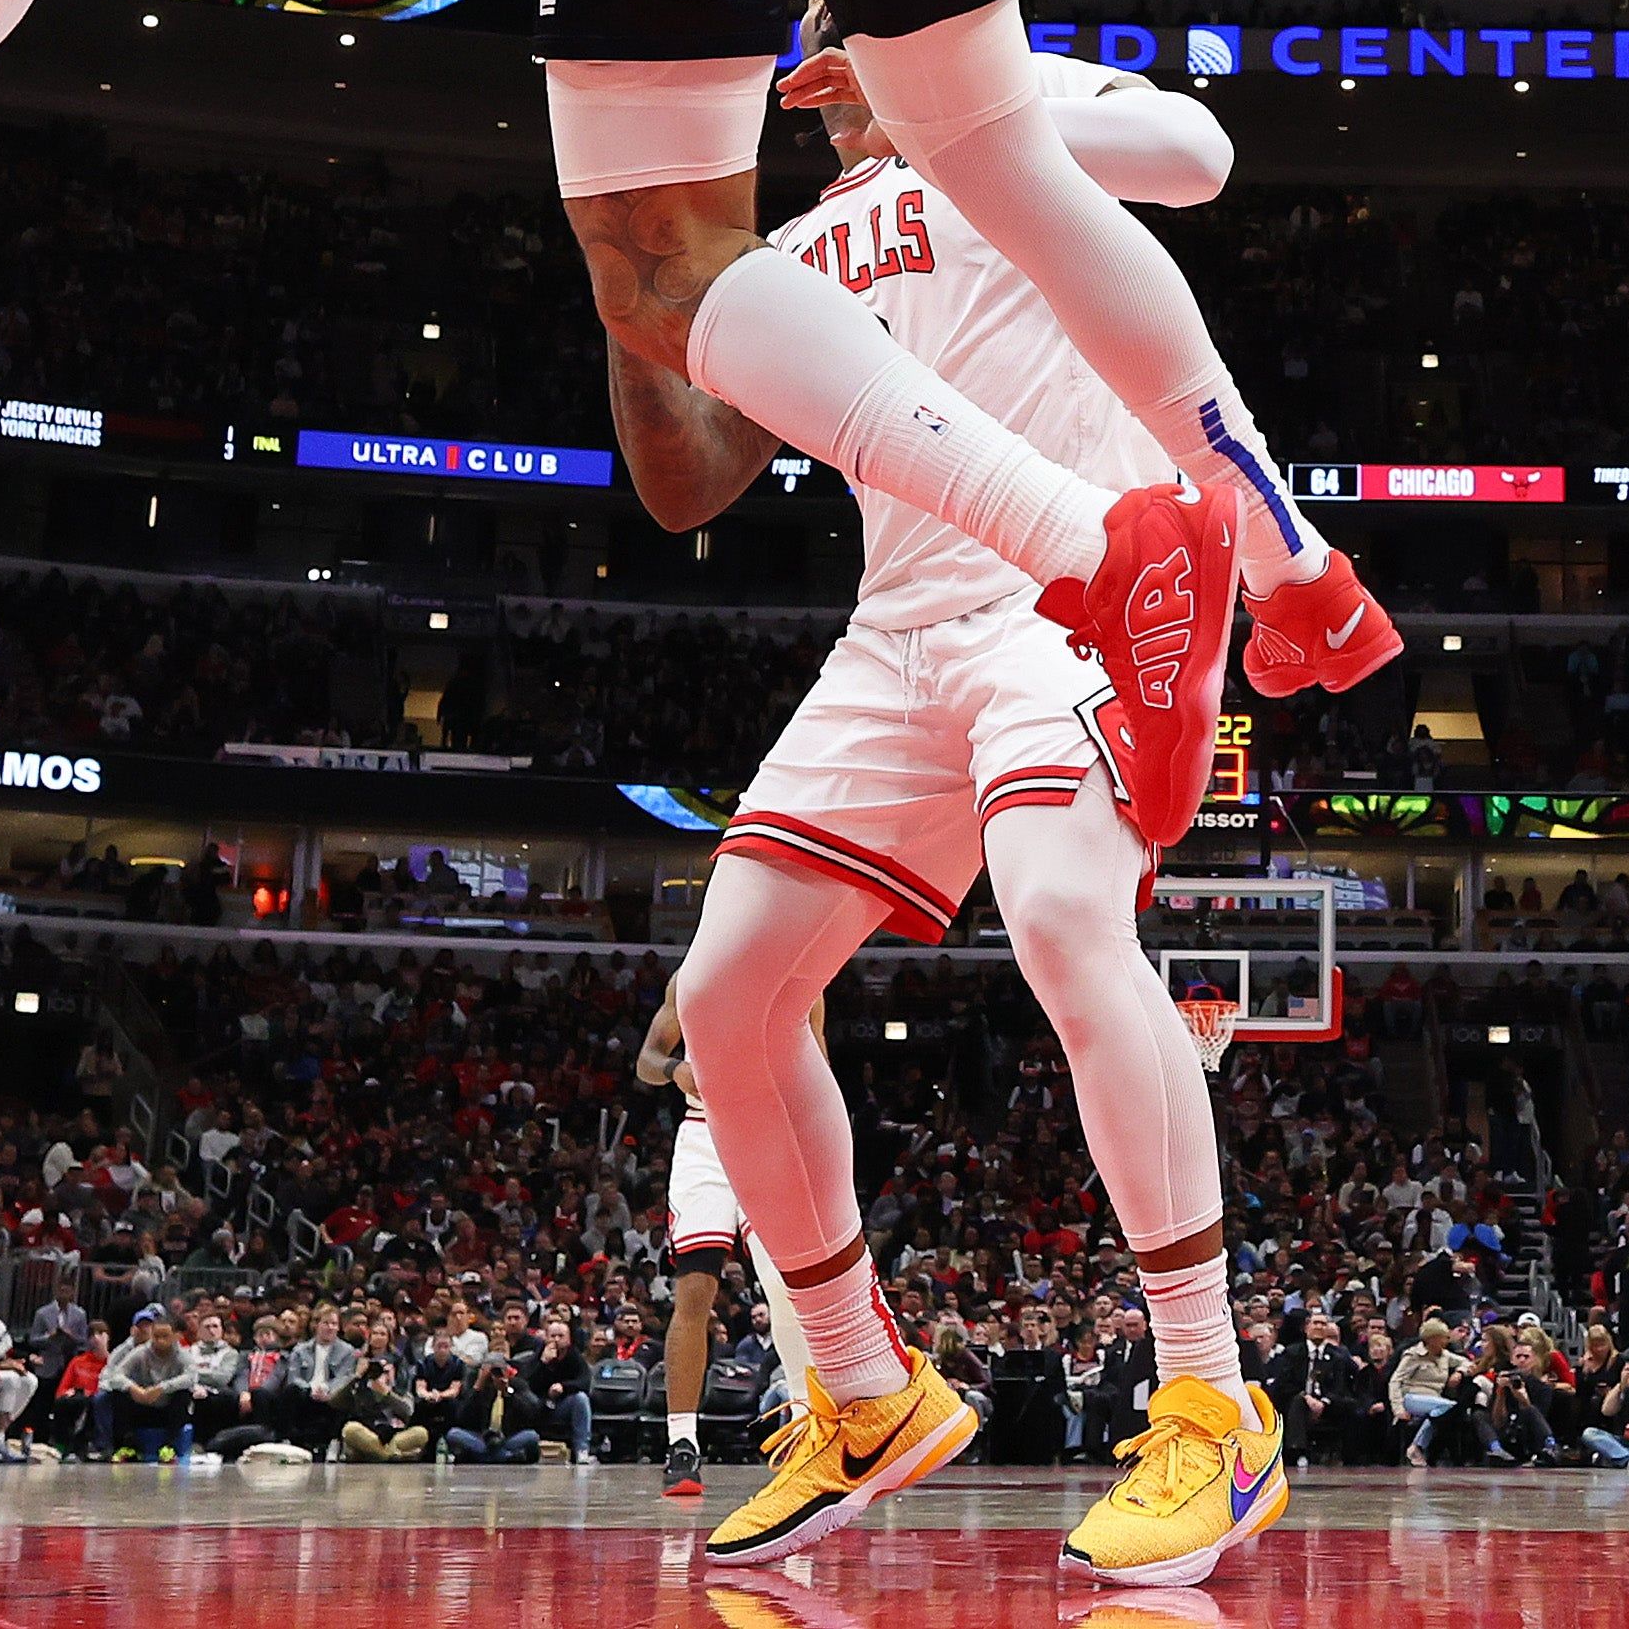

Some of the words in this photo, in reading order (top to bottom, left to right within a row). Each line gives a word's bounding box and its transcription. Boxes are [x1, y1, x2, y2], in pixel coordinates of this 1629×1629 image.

[1, 399, 54, 423] JERSEY
[55, 405, 103, 430] DEVILS
[0, 419, 36, 440] YORK
[38, 423, 102, 448] RANGERS
[352, 441, 437, 467] ULTRA
[467, 449, 559, 475] CLUB
[1310, 468, 1339, 496] 64
[1388, 468, 1474, 497] CHICAGO
[1126, 545, 1195, 710] AIR
